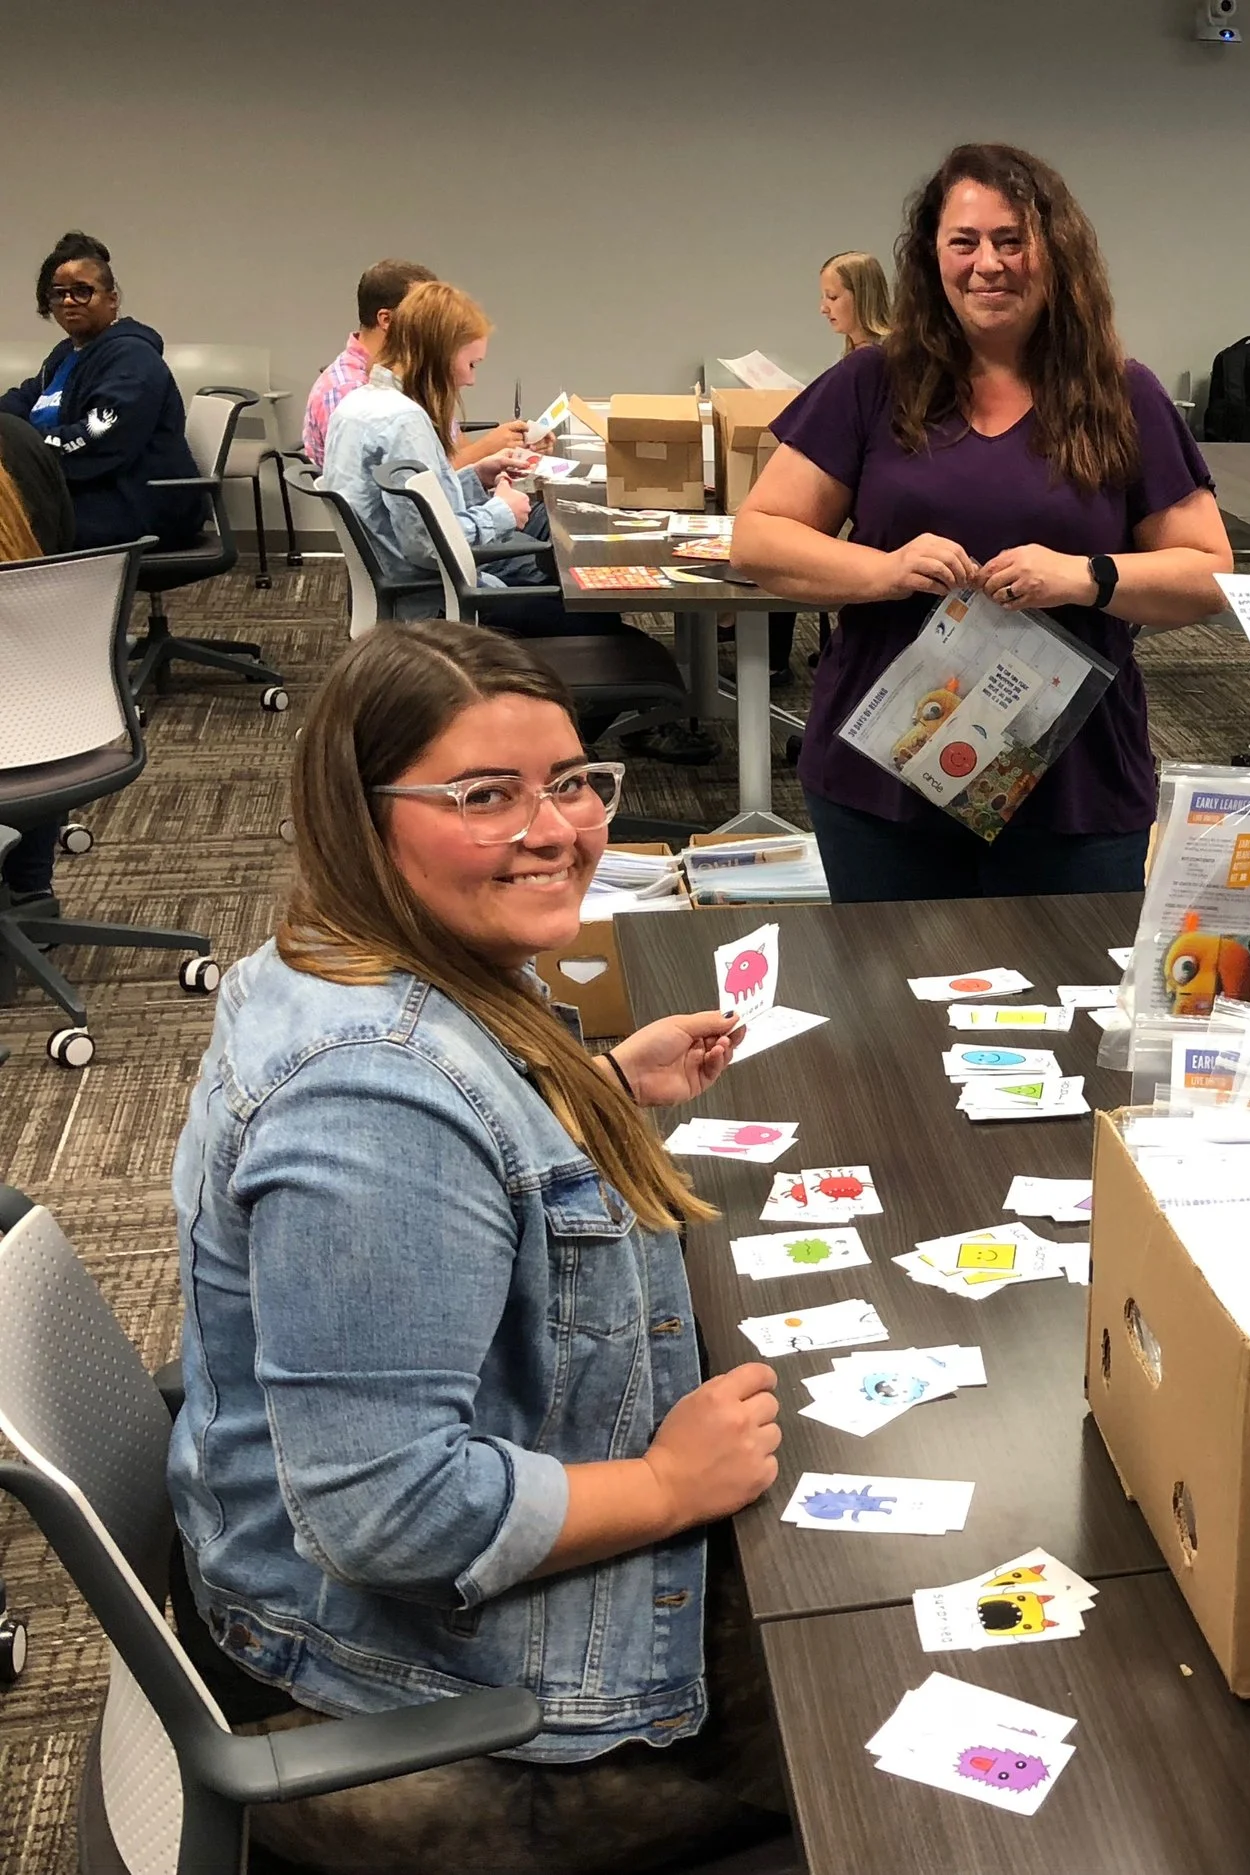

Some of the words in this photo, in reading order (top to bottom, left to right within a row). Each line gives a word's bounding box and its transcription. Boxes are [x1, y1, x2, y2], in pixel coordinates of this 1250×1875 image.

[63, 437, 86, 453] DTE
[853, 715, 867, 731] DAYS
[868, 688, 888, 710] READING
[922, 771, 944, 793] circle
[1196, 797, 1219, 810] EARLY
[1191, 1055, 1217, 1070] EARL
[932, 1593, 954, 1644] surprsed
